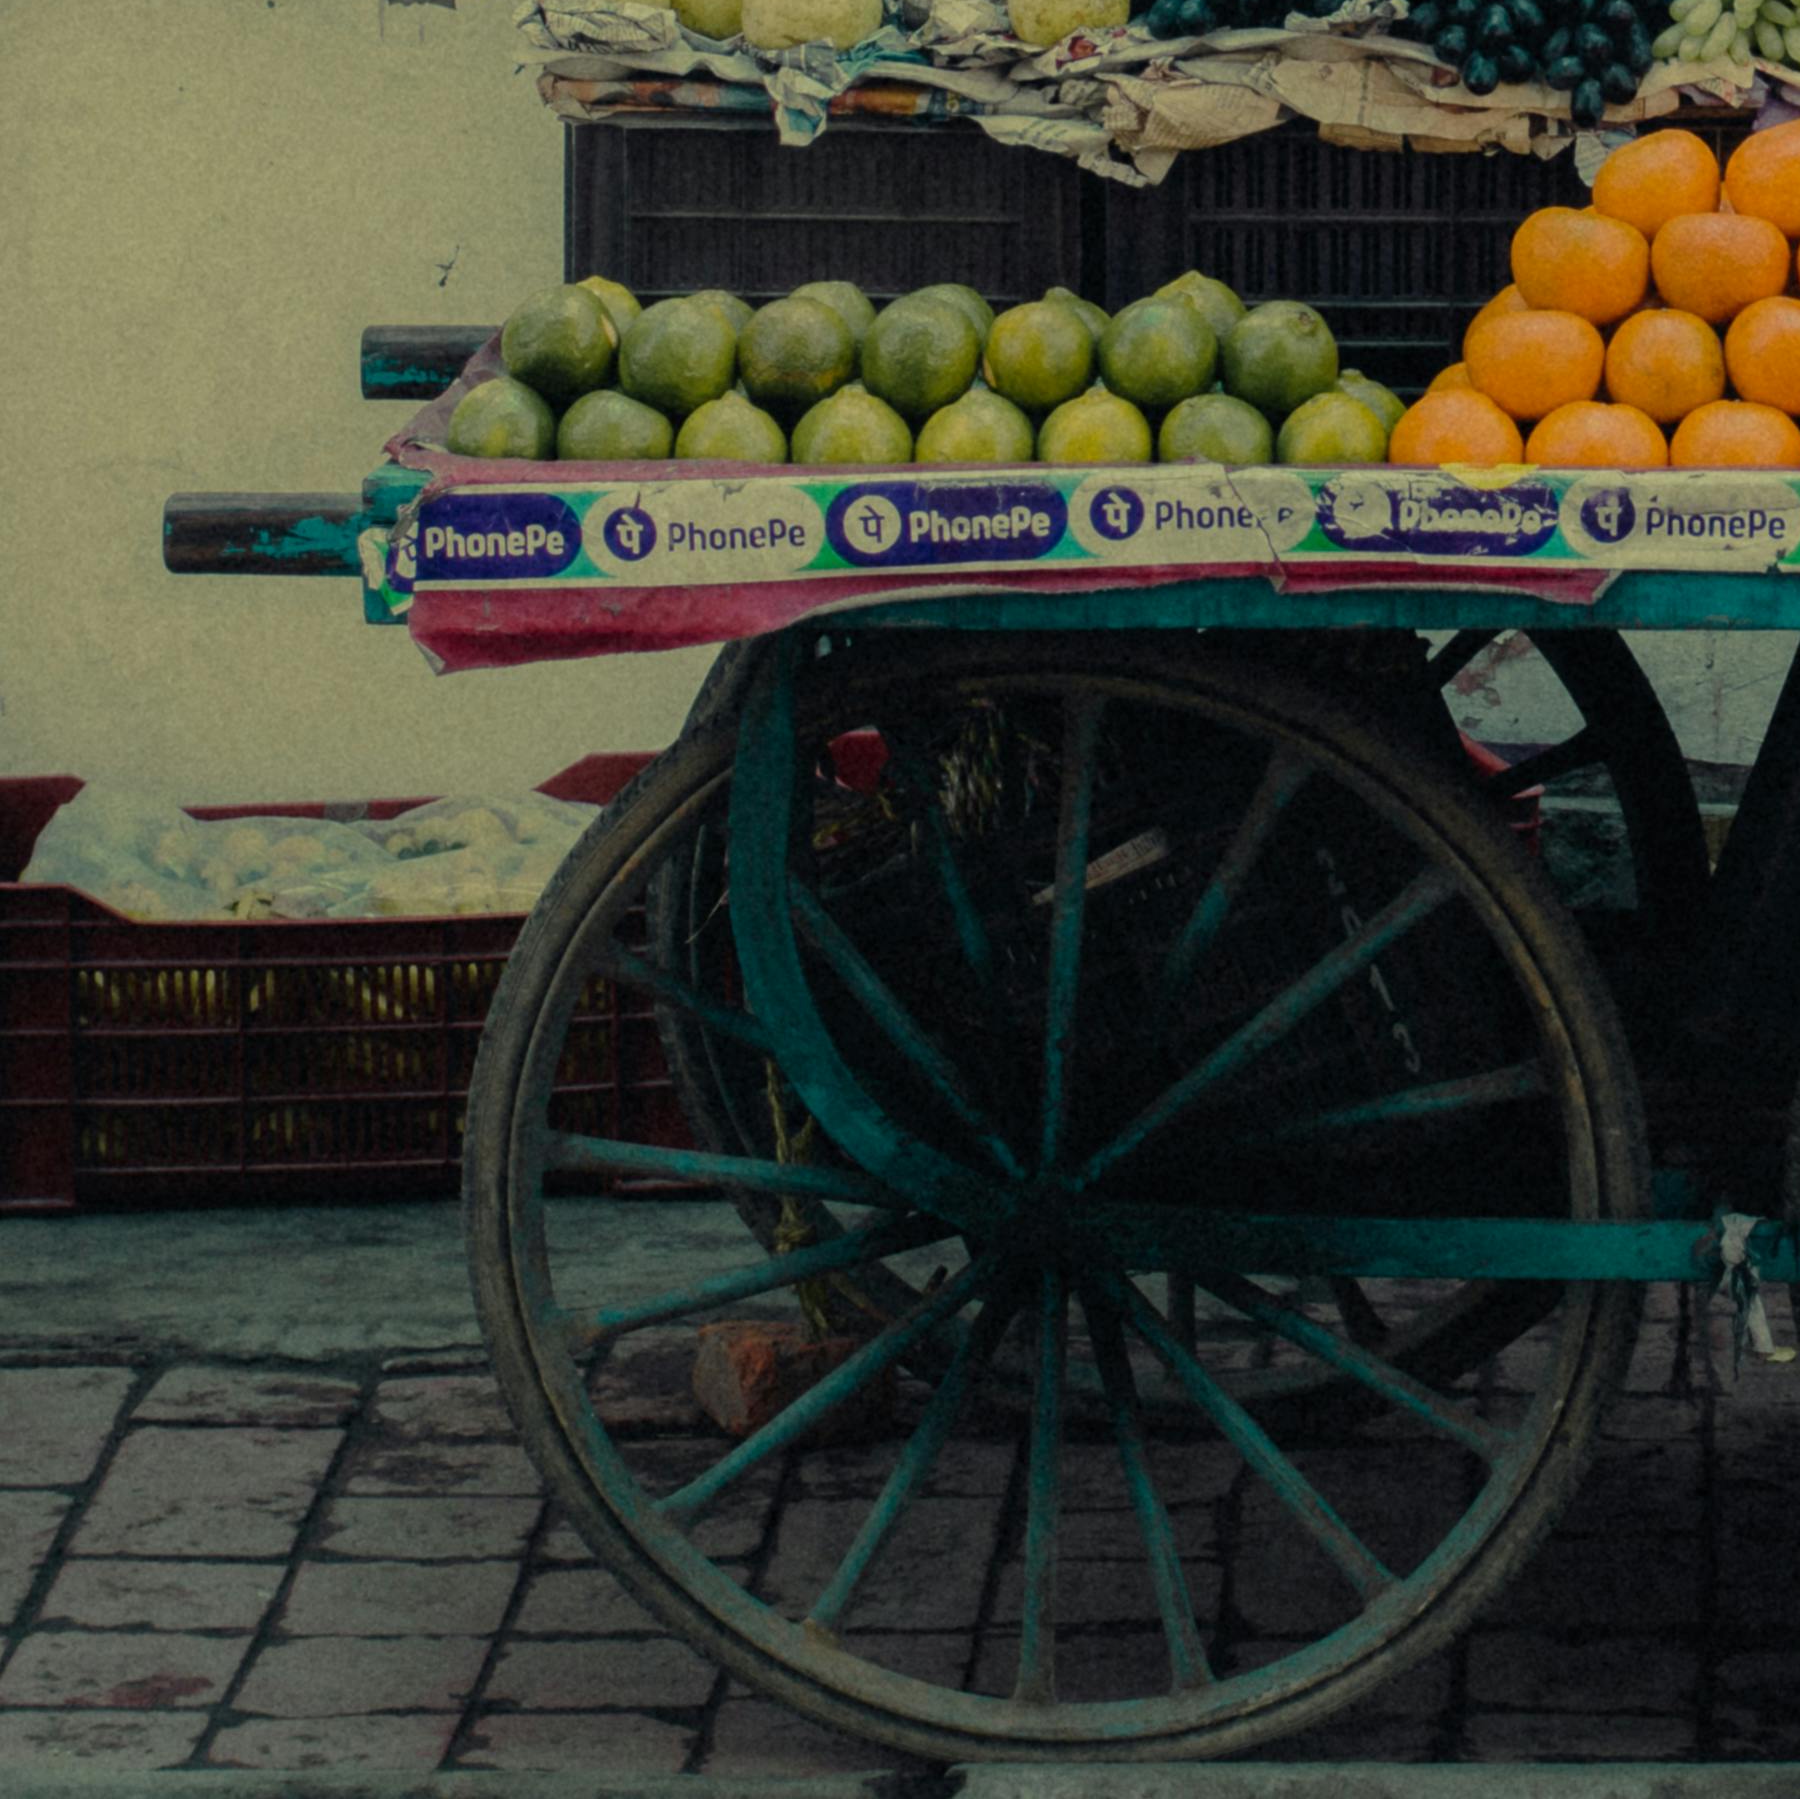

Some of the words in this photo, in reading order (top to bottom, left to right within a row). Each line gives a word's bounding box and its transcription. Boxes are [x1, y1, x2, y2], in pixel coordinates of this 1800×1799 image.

[669, 518, 806, 552] PhonePe
[909, 503, 1051, 543] PhonePe
[1646, 507, 1786, 540] PhonePe
[425, 525, 566, 559] PhonePe
